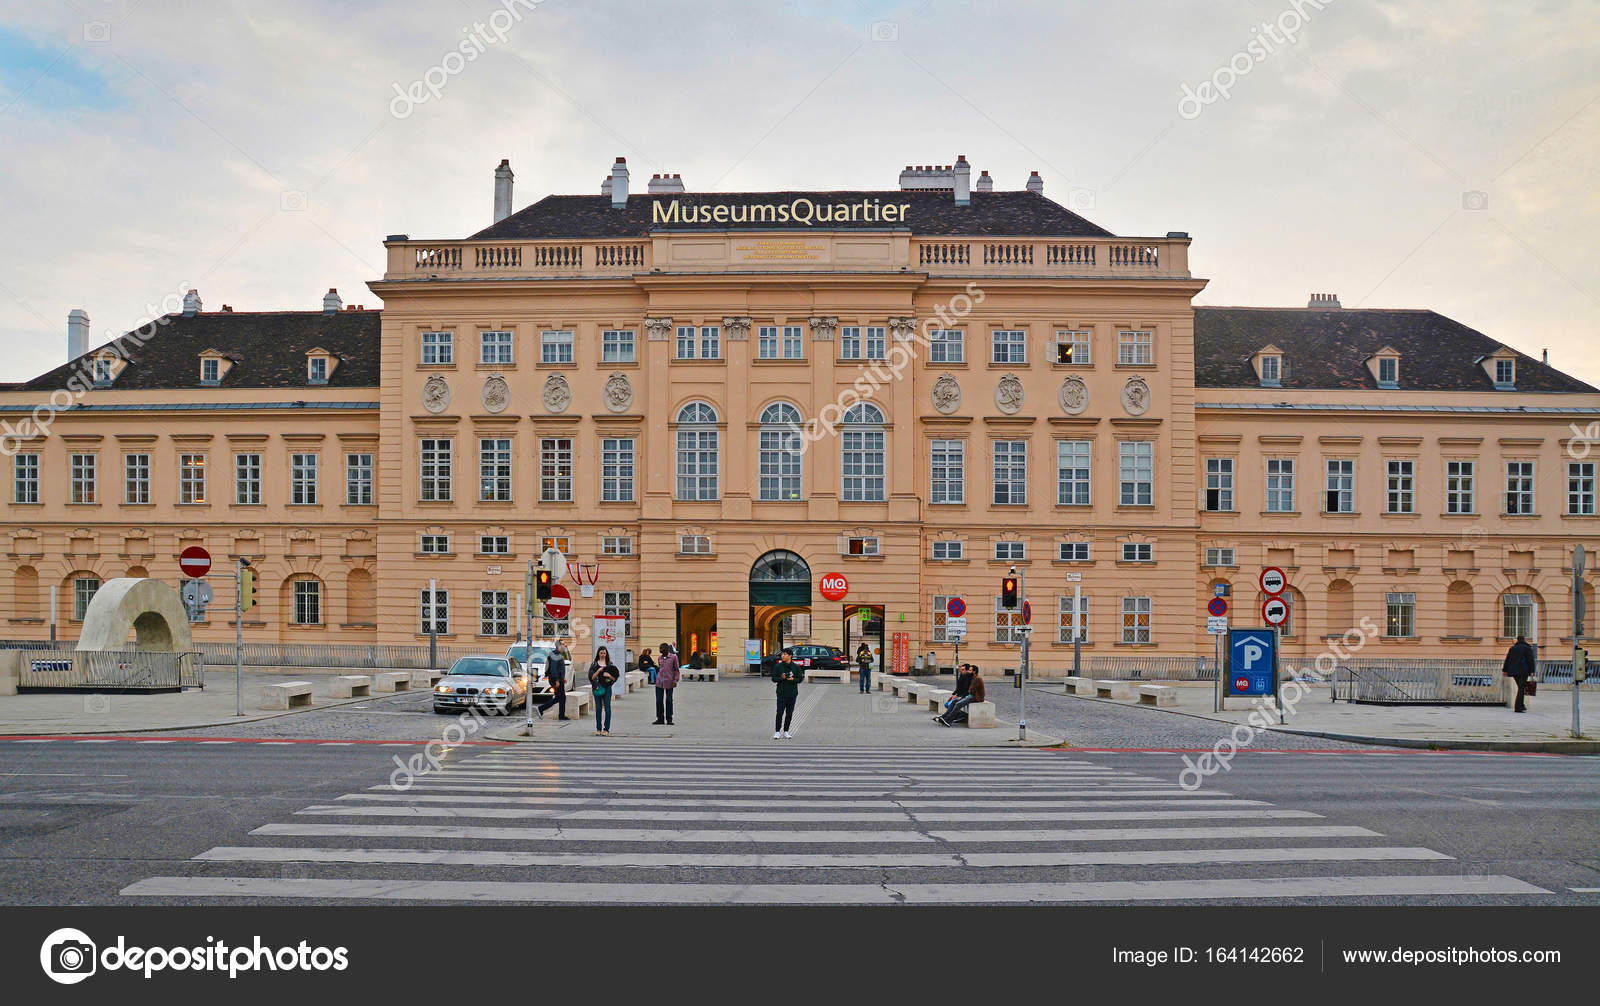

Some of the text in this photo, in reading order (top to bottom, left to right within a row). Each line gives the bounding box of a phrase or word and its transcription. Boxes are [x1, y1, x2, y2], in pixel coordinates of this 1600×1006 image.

[652, 198, 910, 225] MuseumsQuartier
[822, 578, 847, 590] MQ
[1244, 645, 1262, 669] P
